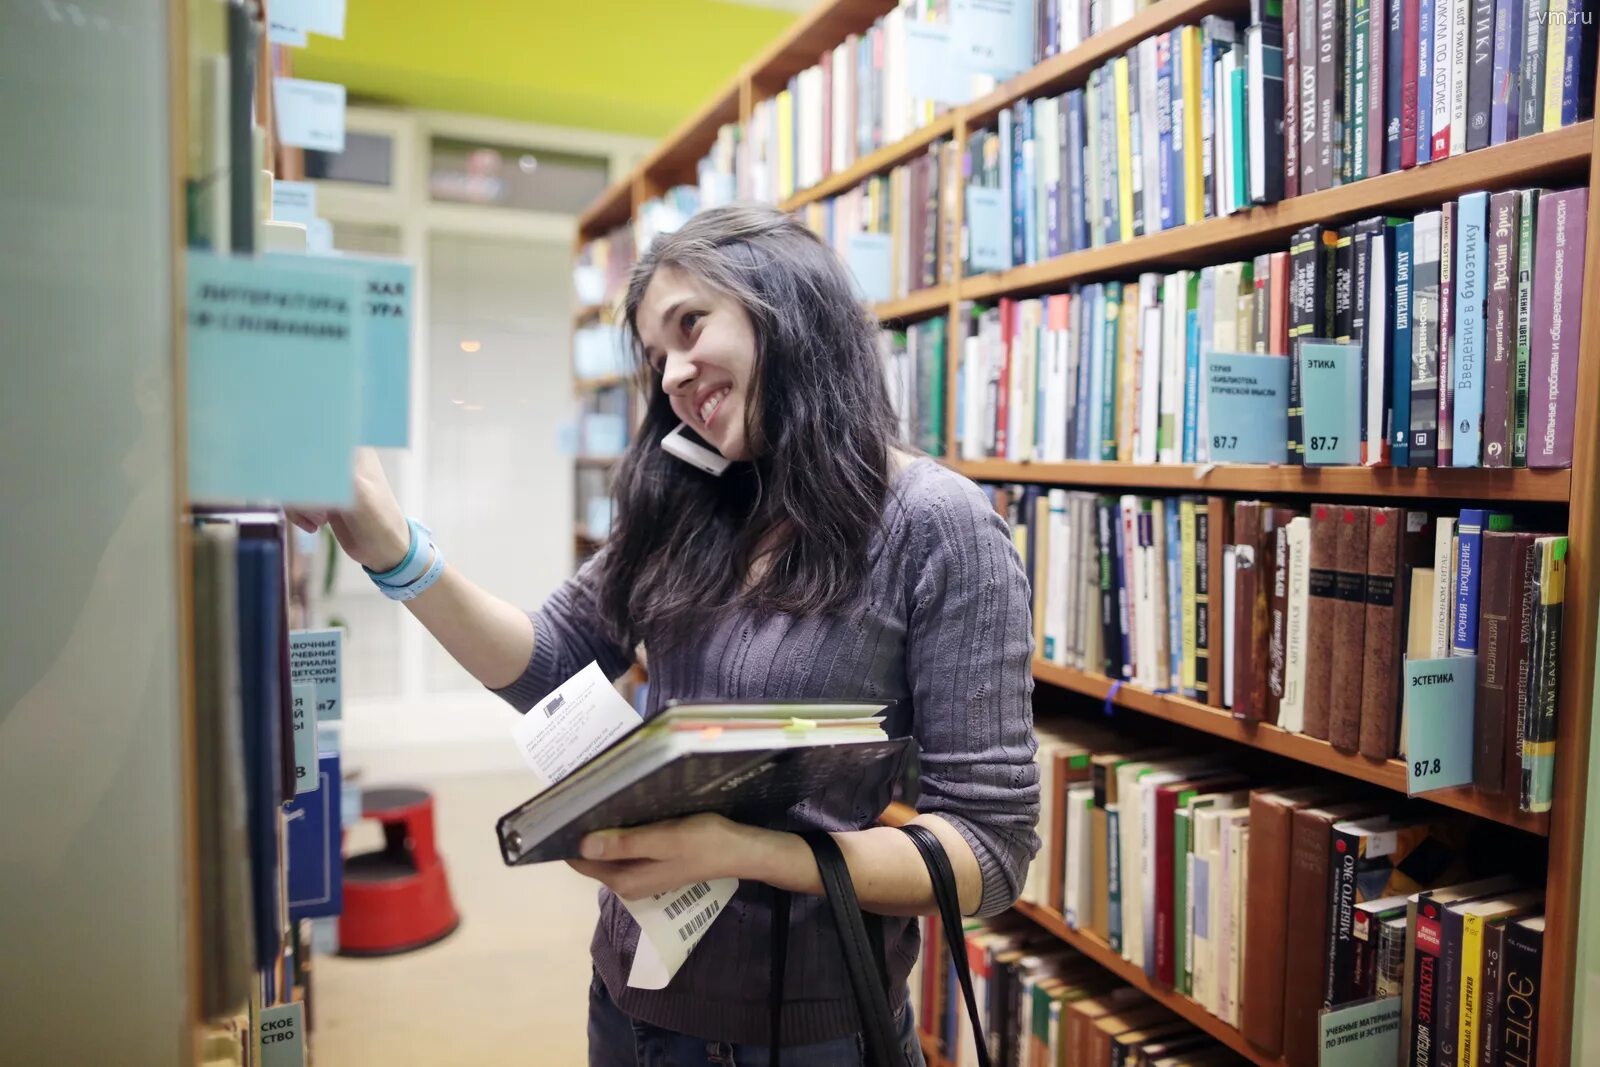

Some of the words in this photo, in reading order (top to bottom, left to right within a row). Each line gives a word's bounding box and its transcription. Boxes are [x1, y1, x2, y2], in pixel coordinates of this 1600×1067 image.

[1456, 6, 1466, 26] ДЛЯ
[1475, 0, 1492, 64] ГИКА
[1356, 33, 1364, 69] ЛОГИКА
[1420, 38, 1428, 77] ЛОГИКА
[1436, 44, 1447, 63] ПО
[1456, 29, 1465, 65] ЛОГИКА
[1355, 71, 1364, 80] В
[1435, 67, 1447, 116] ЛОГИКЕ
[1303, 65, 1316, 145] ЛОГИКА
[1355, 82, 1364, 114] ЛИЦАХ
[1321, 99, 1330, 143] ДЕМИДОВ
[1355, 115, 1363, 124] И
[1354, 127, 1363, 177] СИМВОЛАХ
[1496, 206, 1510, 238] Эрос
[1556, 199, 1567, 247] ценности
[1305, 262, 1315, 295] ЭТИКЕ
[1358, 253, 1366, 275] ВОЛИ
[1397, 251, 1409, 283] БОГАТ
[1461, 224, 1480, 300] биоэтику
[1493, 244, 1509, 292] Русский
[1304, 297, 1314, 313] ПО
[1356, 276, 1365, 312] СВОБОДА
[1396, 284, 1408, 330] ЕВГЕНИЙ
[1464, 305, 1475, 313] в
[1518, 287, 1528, 317] УЧЕНИЕ
[1552, 250, 1565, 341] общечеловеческие
[1418, 298, 1428, 384] НРАВСТВЕННОСТЬ
[1517, 325, 1528, 347] ЦВЕТЕ
[1210, 364, 1232, 373] СЕРИЯ
[1307, 359, 1336, 369] ЭТИКА
[1458, 316, 1474, 390] Введение
[1517, 360, 1527, 388] ТЕОРИЯ
[1548, 352, 1560, 400] проблемы
[1211, 387, 1249, 396] ЭТИЧЕСКОЙ
[1213, 436, 1238, 449] 87.7
[1310, 436, 1339, 451] 87.7
[1542, 401, 1557, 456] Глобальные
[1293, 539, 1304, 597] ЭСТЕТИКА
[1441, 553, 1449, 583] КИТАЕ
[1460, 542, 1472, 597] ПРОЩЕНИЕ
[1457, 603, 1468, 642] ИРОНИЯ
[1520, 590, 1532, 644] КУЛЬТУРА
[1290, 605, 1301, 664] АНТИЧНАЯ
[292, 667, 336, 678] ДЕТСКОЙ
[1411, 673, 1455, 688] ЭСТЕТИКА
[1519, 658, 1529, 712] ШВЕЙЦЕР
[1516, 714, 1527, 758] АЛЬБЕРТ
[1413, 758, 1442, 778] 87.8
[1342, 854, 1355, 882] ЭКО
[1338, 883, 1354, 941] УМБЕРТО
[1418, 956, 1434, 1024] ЭТИКЕТА
[260, 1017, 293, 1032] СКОЕ
[261, 1031, 294, 1045] СТВО
[1325, 1020, 1358, 1038] УЧЕБНЫЕ
[1359, 1008, 1402, 1029] МАТЕРИАЛЫ
[1325, 1039, 1336, 1050] ПО
[1336, 1033, 1359, 1047] ЭТИКЕ
[1359, 1031, 1366, 1040] И
[1365, 1022, 1399, 1040] ЭСТЕТИКЕ
